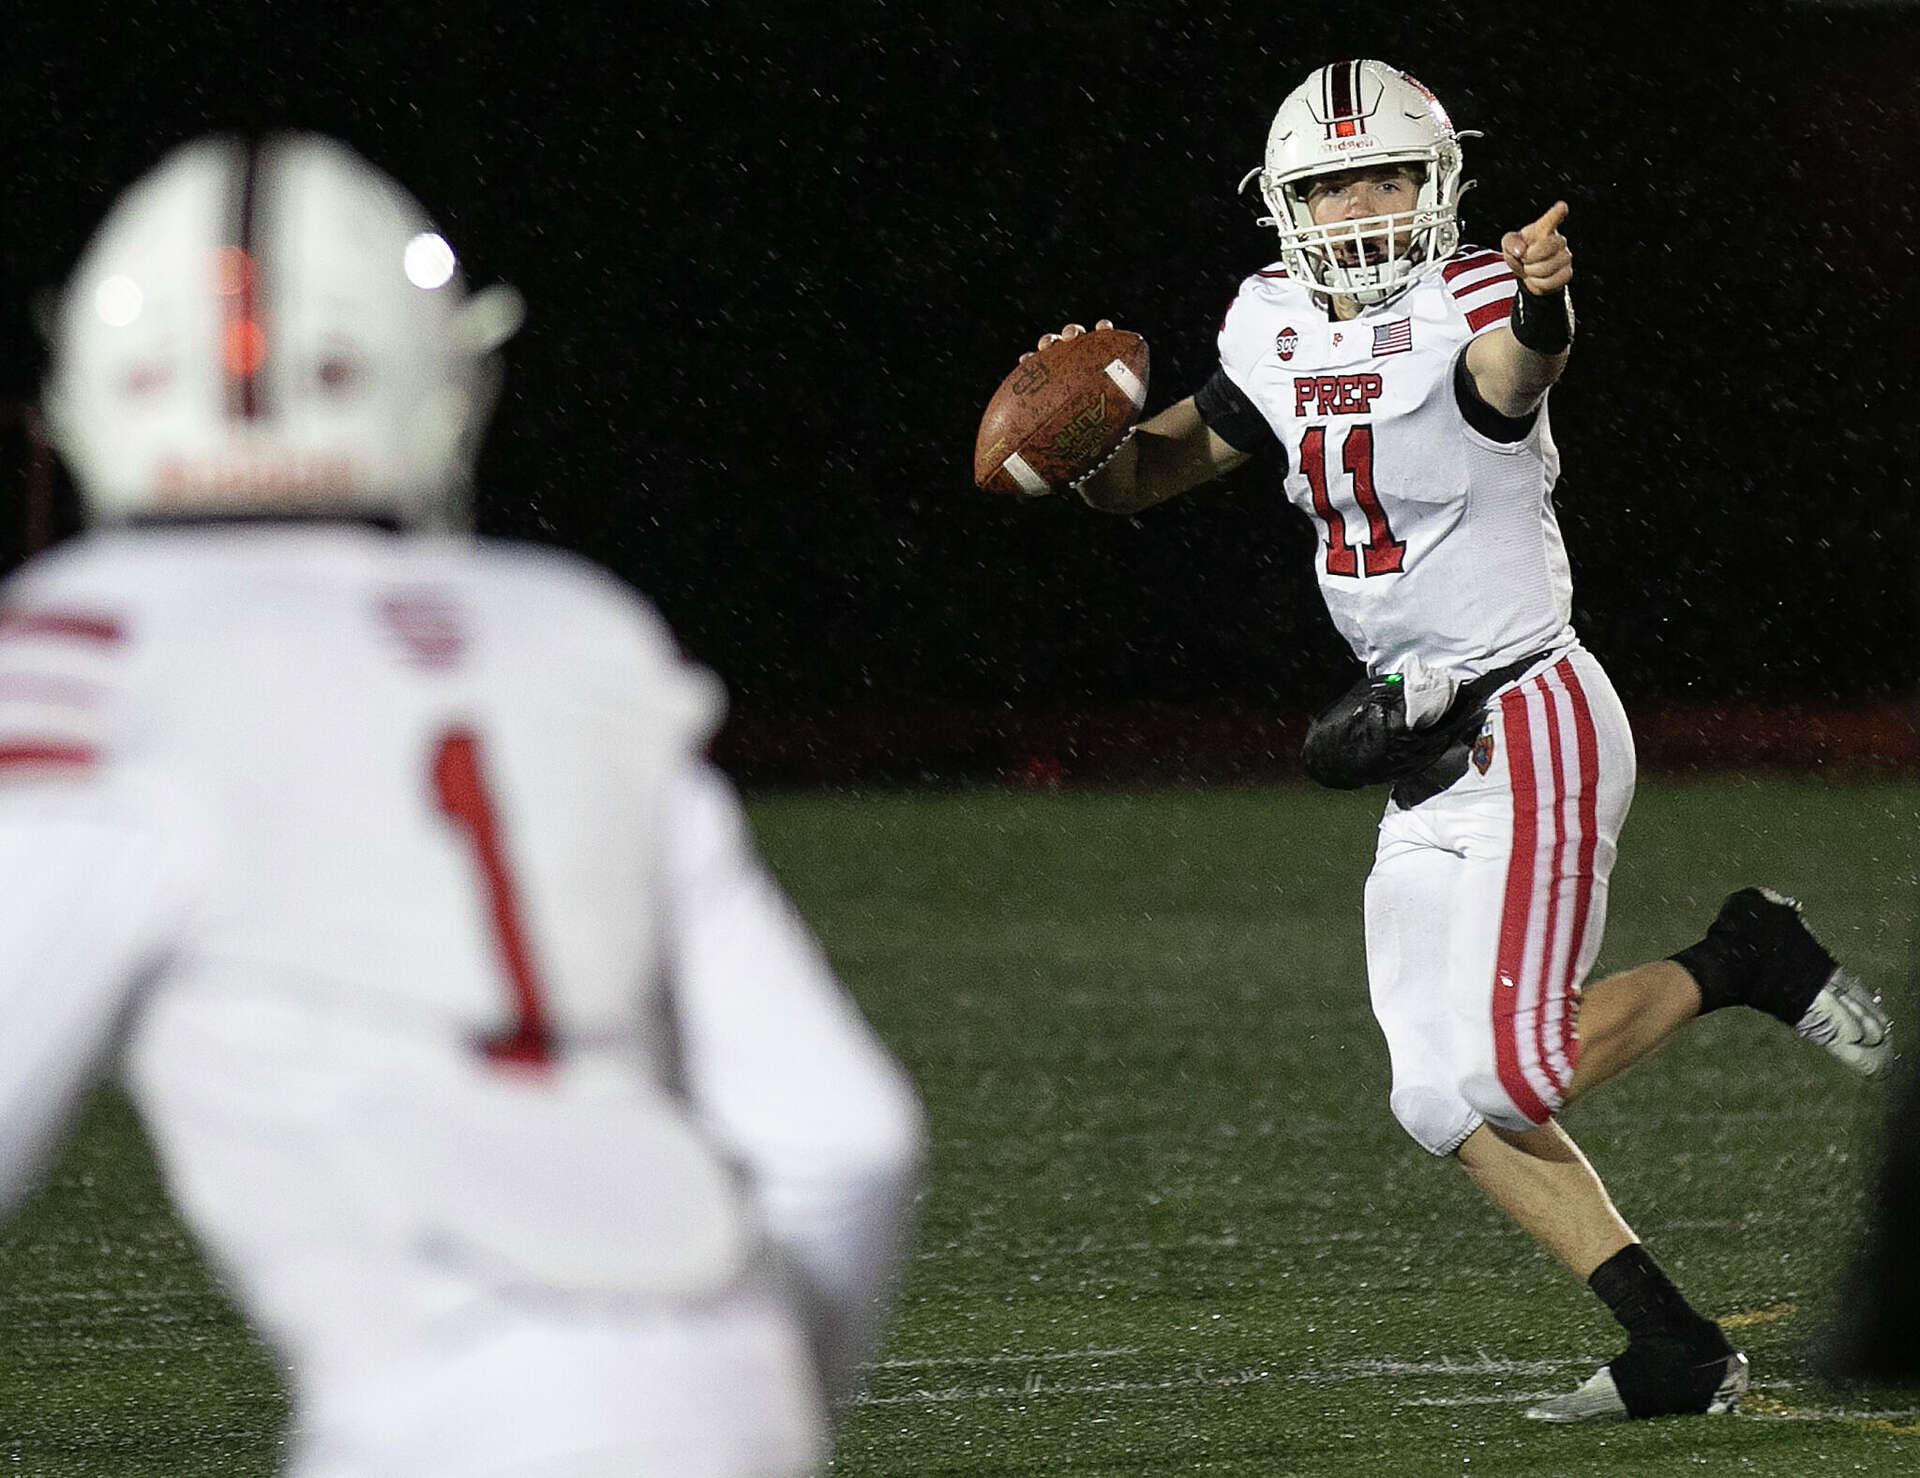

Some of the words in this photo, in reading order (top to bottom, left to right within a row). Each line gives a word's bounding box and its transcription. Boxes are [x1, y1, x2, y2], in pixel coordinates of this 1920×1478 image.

[1276, 337, 1299, 351] SCC
[1294, 373, 1383, 417] PREP
[1299, 424, 1407, 578] 11
[428, 728, 565, 1078] 1
